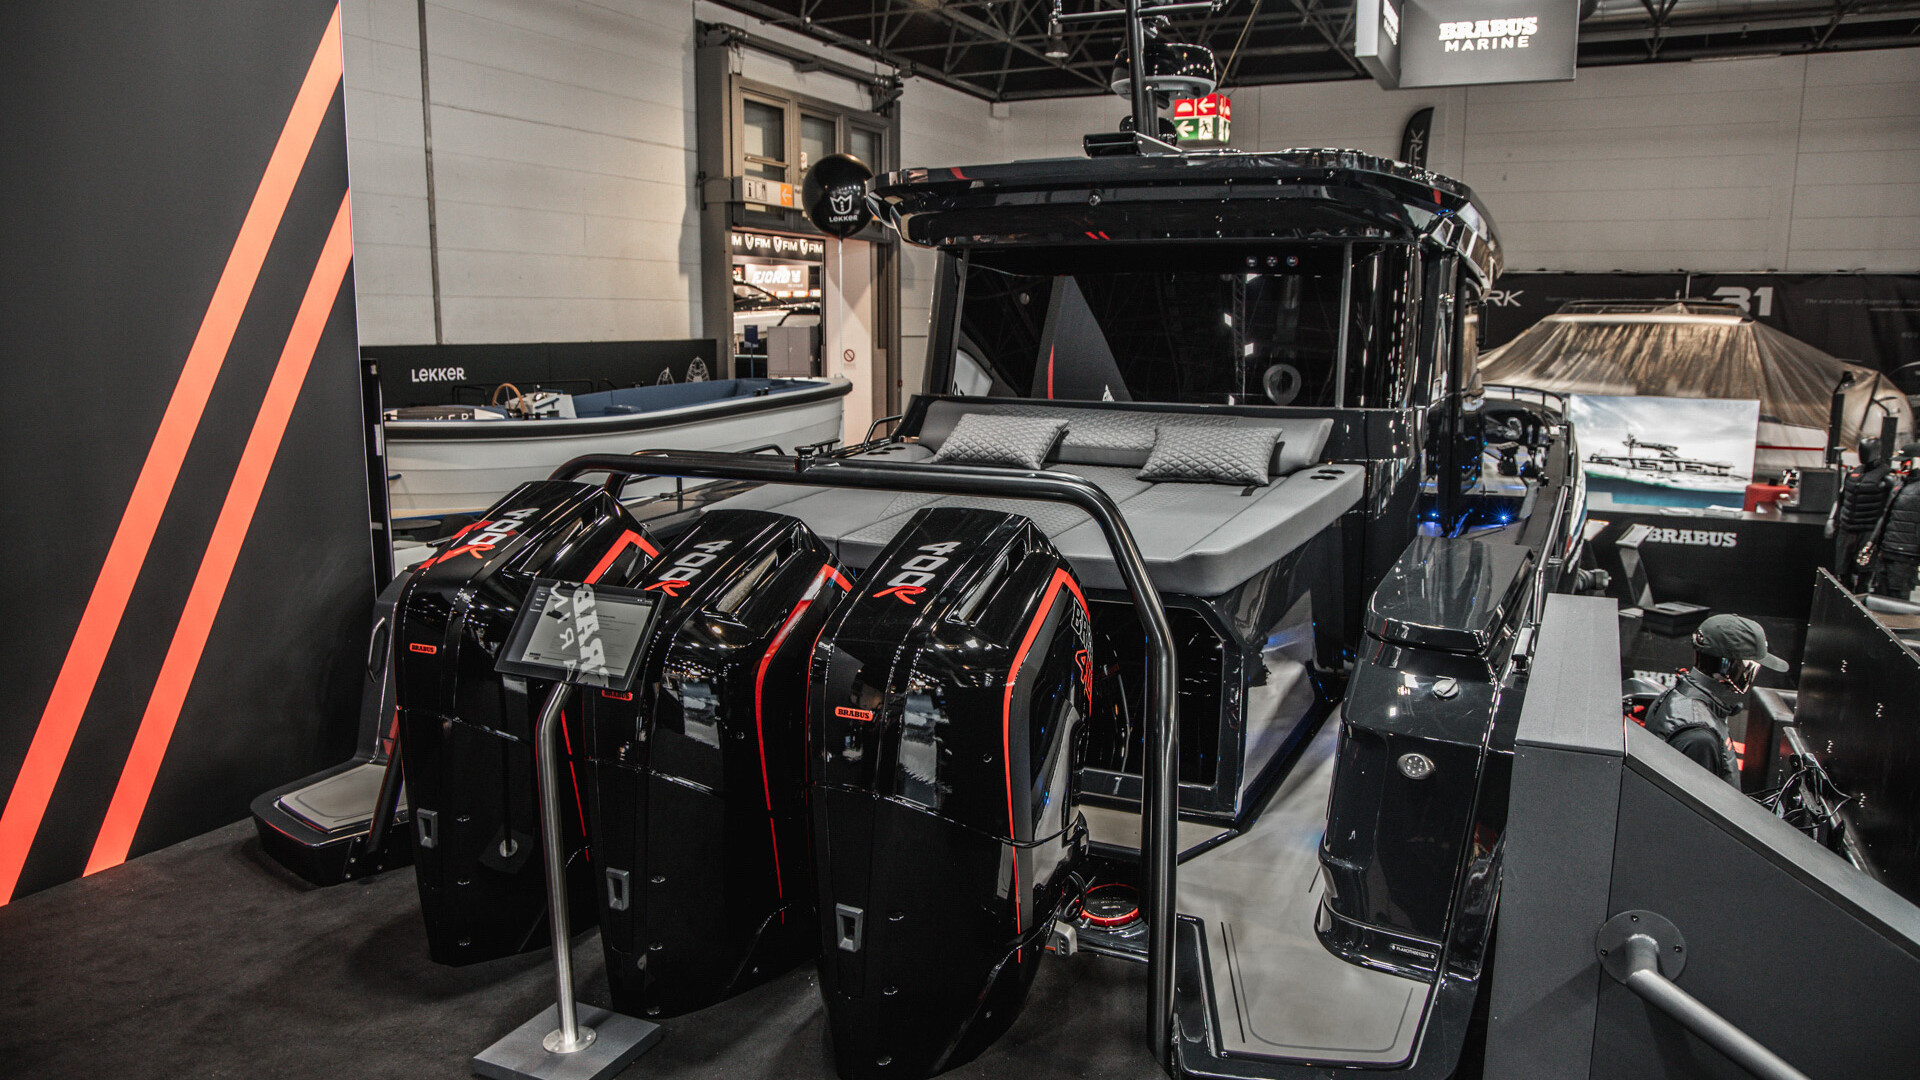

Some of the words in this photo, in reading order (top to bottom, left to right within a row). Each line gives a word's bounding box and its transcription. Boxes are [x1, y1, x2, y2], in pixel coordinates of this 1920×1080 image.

[1439, 17, 1537, 40] BRABUS
[1444, 36, 1529, 52] MARINE
[755, 237, 771, 249] FIM
[783, 240, 797, 251] FIM
[1646, 527, 1738, 548] BRABUS
[838, 708, 870, 719] BRABUS
